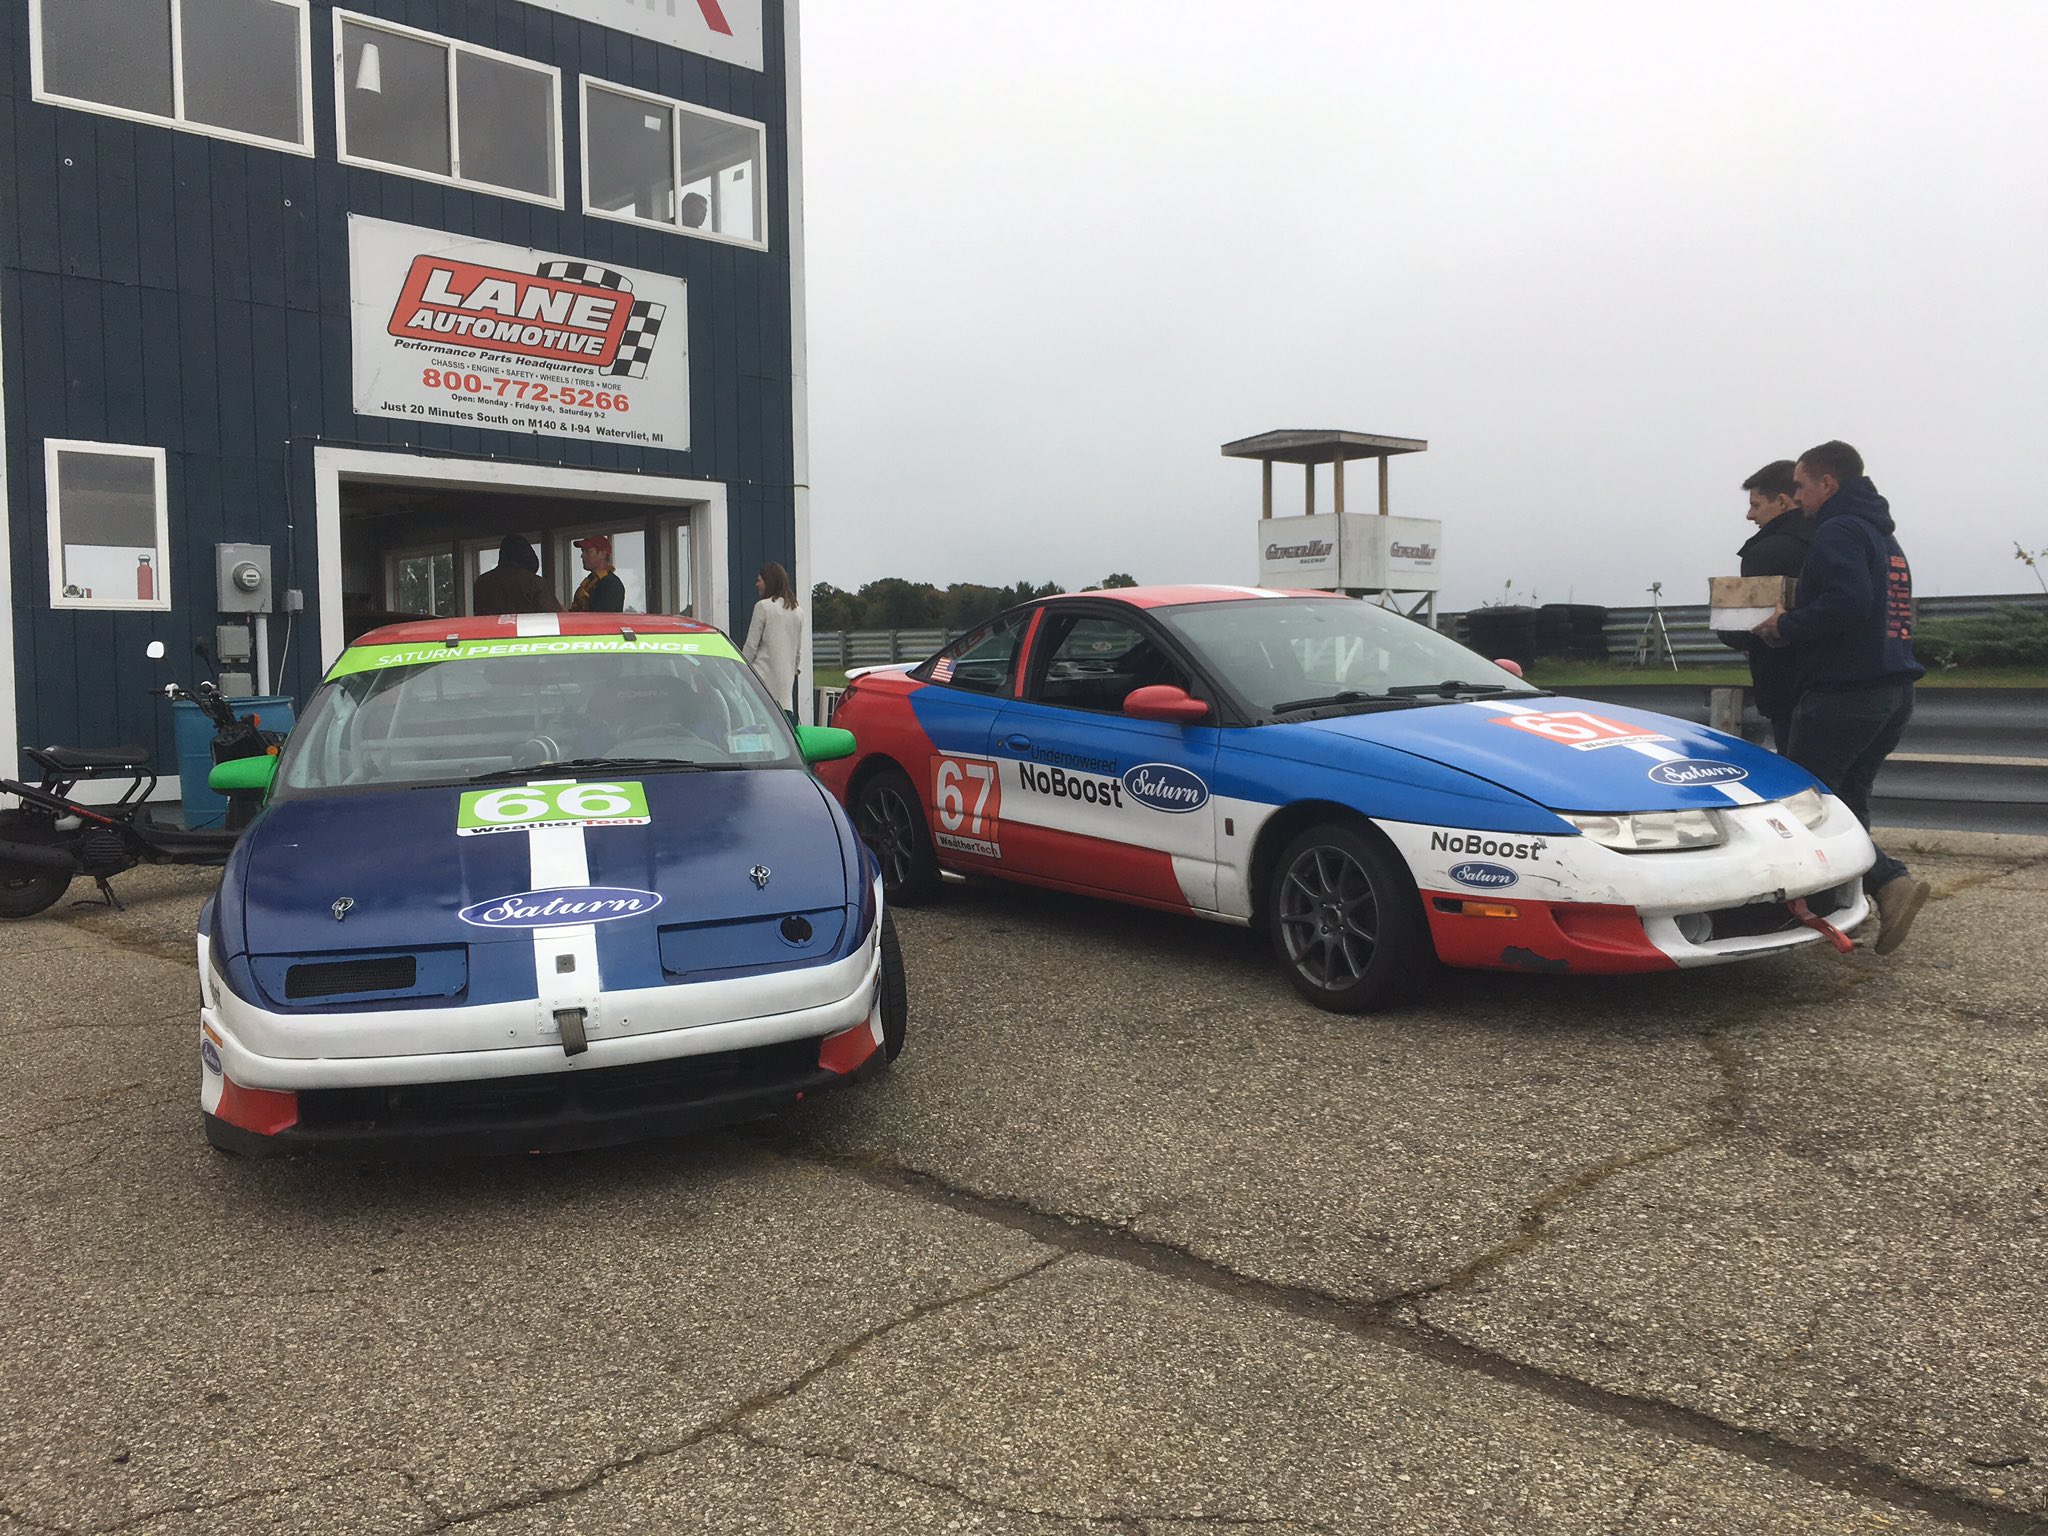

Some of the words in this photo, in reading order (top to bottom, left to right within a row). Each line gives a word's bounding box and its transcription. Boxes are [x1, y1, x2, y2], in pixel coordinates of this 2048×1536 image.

[420, 268, 617, 332] LANE
[406, 309, 606, 356] AUTOMOTIVE
[394, 339, 476, 358] Performance
[479, 351, 512, 364] Parts
[515, 356, 595, 376] Headquarters
[431, 358, 466, 370] CHASSIS
[471, 364, 500, 375] ENGINE
[505, 368, 534, 379] SAFETY
[540, 373, 570, 385] WHEELS
[575, 379, 595, 388] TIRES
[602, 382, 621, 391] MORE
[422, 368, 629, 413] 800-772-5266
[451, 393, 476, 404] Open:
[477, 397, 508, 409] Monday
[515, 402, 539, 413] Friday
[540, 404, 555, 415] 9-6,
[559, 406, 593, 419] Saturday
[594, 411, 606, 419] 9-2
[381, 401, 407, 413] Just
[410, 404, 425, 415] 20
[428, 406, 474, 420] Minutes
[476, 412, 509, 426] South
[511, 418, 526, 427] on
[528, 418, 557, 431] M140
[559, 423, 568, 431] &
[571, 423, 591, 434] I-94
[596, 425, 650, 442] Watervliet,
[652, 432, 664, 443] MI
[375, 647, 464, 666] SATURN
[466, 641, 700, 656] PERFORMANCE
[1510, 711, 1630, 739] 67
[1031, 744, 1118, 774] Underpowered
[1665, 765, 1743, 783] Saturn
[937, 760, 995, 835] 67
[1019, 761, 1123, 809] NoBoost
[1132, 769, 1200, 803] Saturn
[474, 785, 632, 822] 66
[471, 818, 643, 834] WeatherTech
[940, 836, 998, 855] WeatherTech
[1431, 831, 1541, 861] NoBoost
[1457, 865, 1511, 884] Saturn
[483, 897, 643, 922] Saturn
